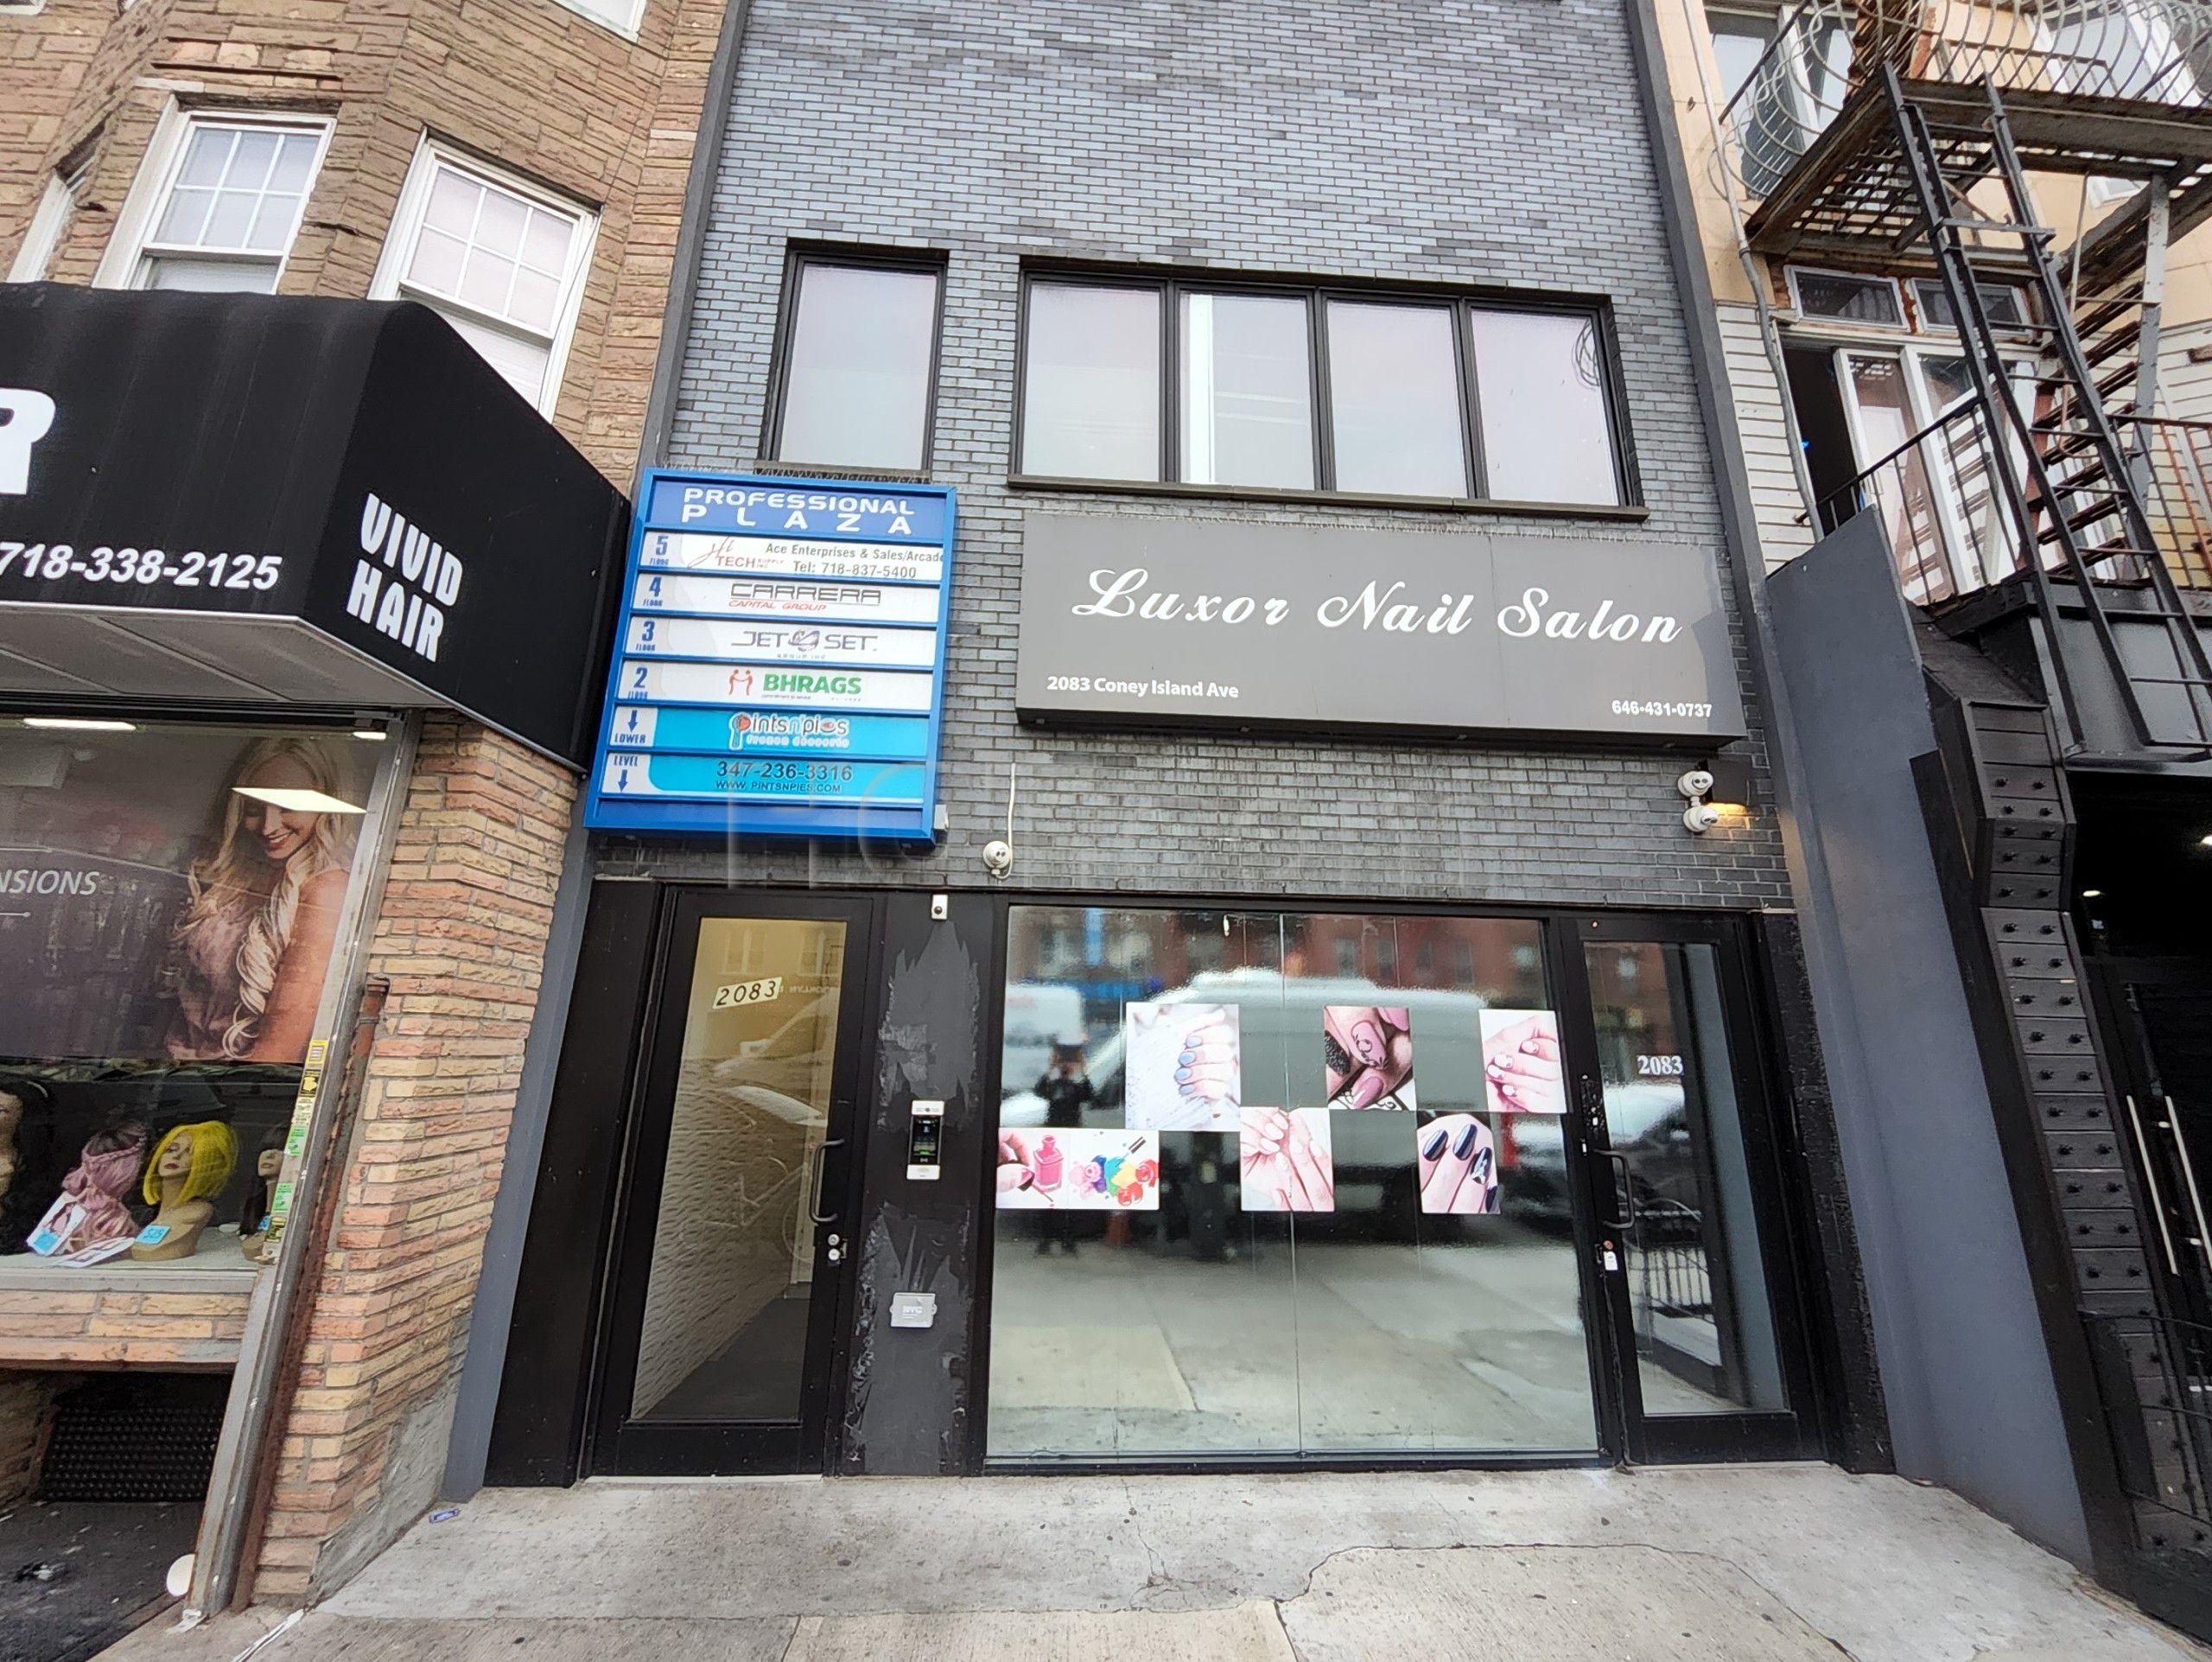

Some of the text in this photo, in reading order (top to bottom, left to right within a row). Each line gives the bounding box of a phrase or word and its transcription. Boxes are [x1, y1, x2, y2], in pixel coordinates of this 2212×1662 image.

[683, 487, 915, 515] PROFESSIONAL
[681, 504, 912, 535] PLAZA
[360, 492, 463, 607] VIVID
[655, 535, 669, 556] 5
[766, 543, 787, 554] Ace
[791, 544, 855, 559] Enterprises
[860, 549, 868, 558] &
[0, 541, 283, 590] 718-338-2125
[717, 555, 755, 569] TECH
[793, 560, 917, 578] Tel: 718-837-5400
[649, 576, 662, 597] 4
[730, 583, 881, 604] CARRERA
[346, 558, 445, 663] HAIR
[728, 600, 827, 611] CAPITAL GROUP
[1071, 568, 1682, 643] Luxor Nail Salon
[641, 621, 656, 641] 3
[731, 630, 790, 648] JET
[633, 667, 647, 688] 2
[762, 673, 862, 695] BHRAGS
[1047, 675, 1239, 698] 2083 Coney Island Ave
[1611, 699, 1713, 718] 646-431-0737
[614, 732, 646, 745] LOWER
[613, 755, 638, 767] LEVEL
[716, 761, 853, 781] 347-236-3316
[715, 980, 777, 1006] 2083
[1637, 1054, 1684, 1075] 2083
